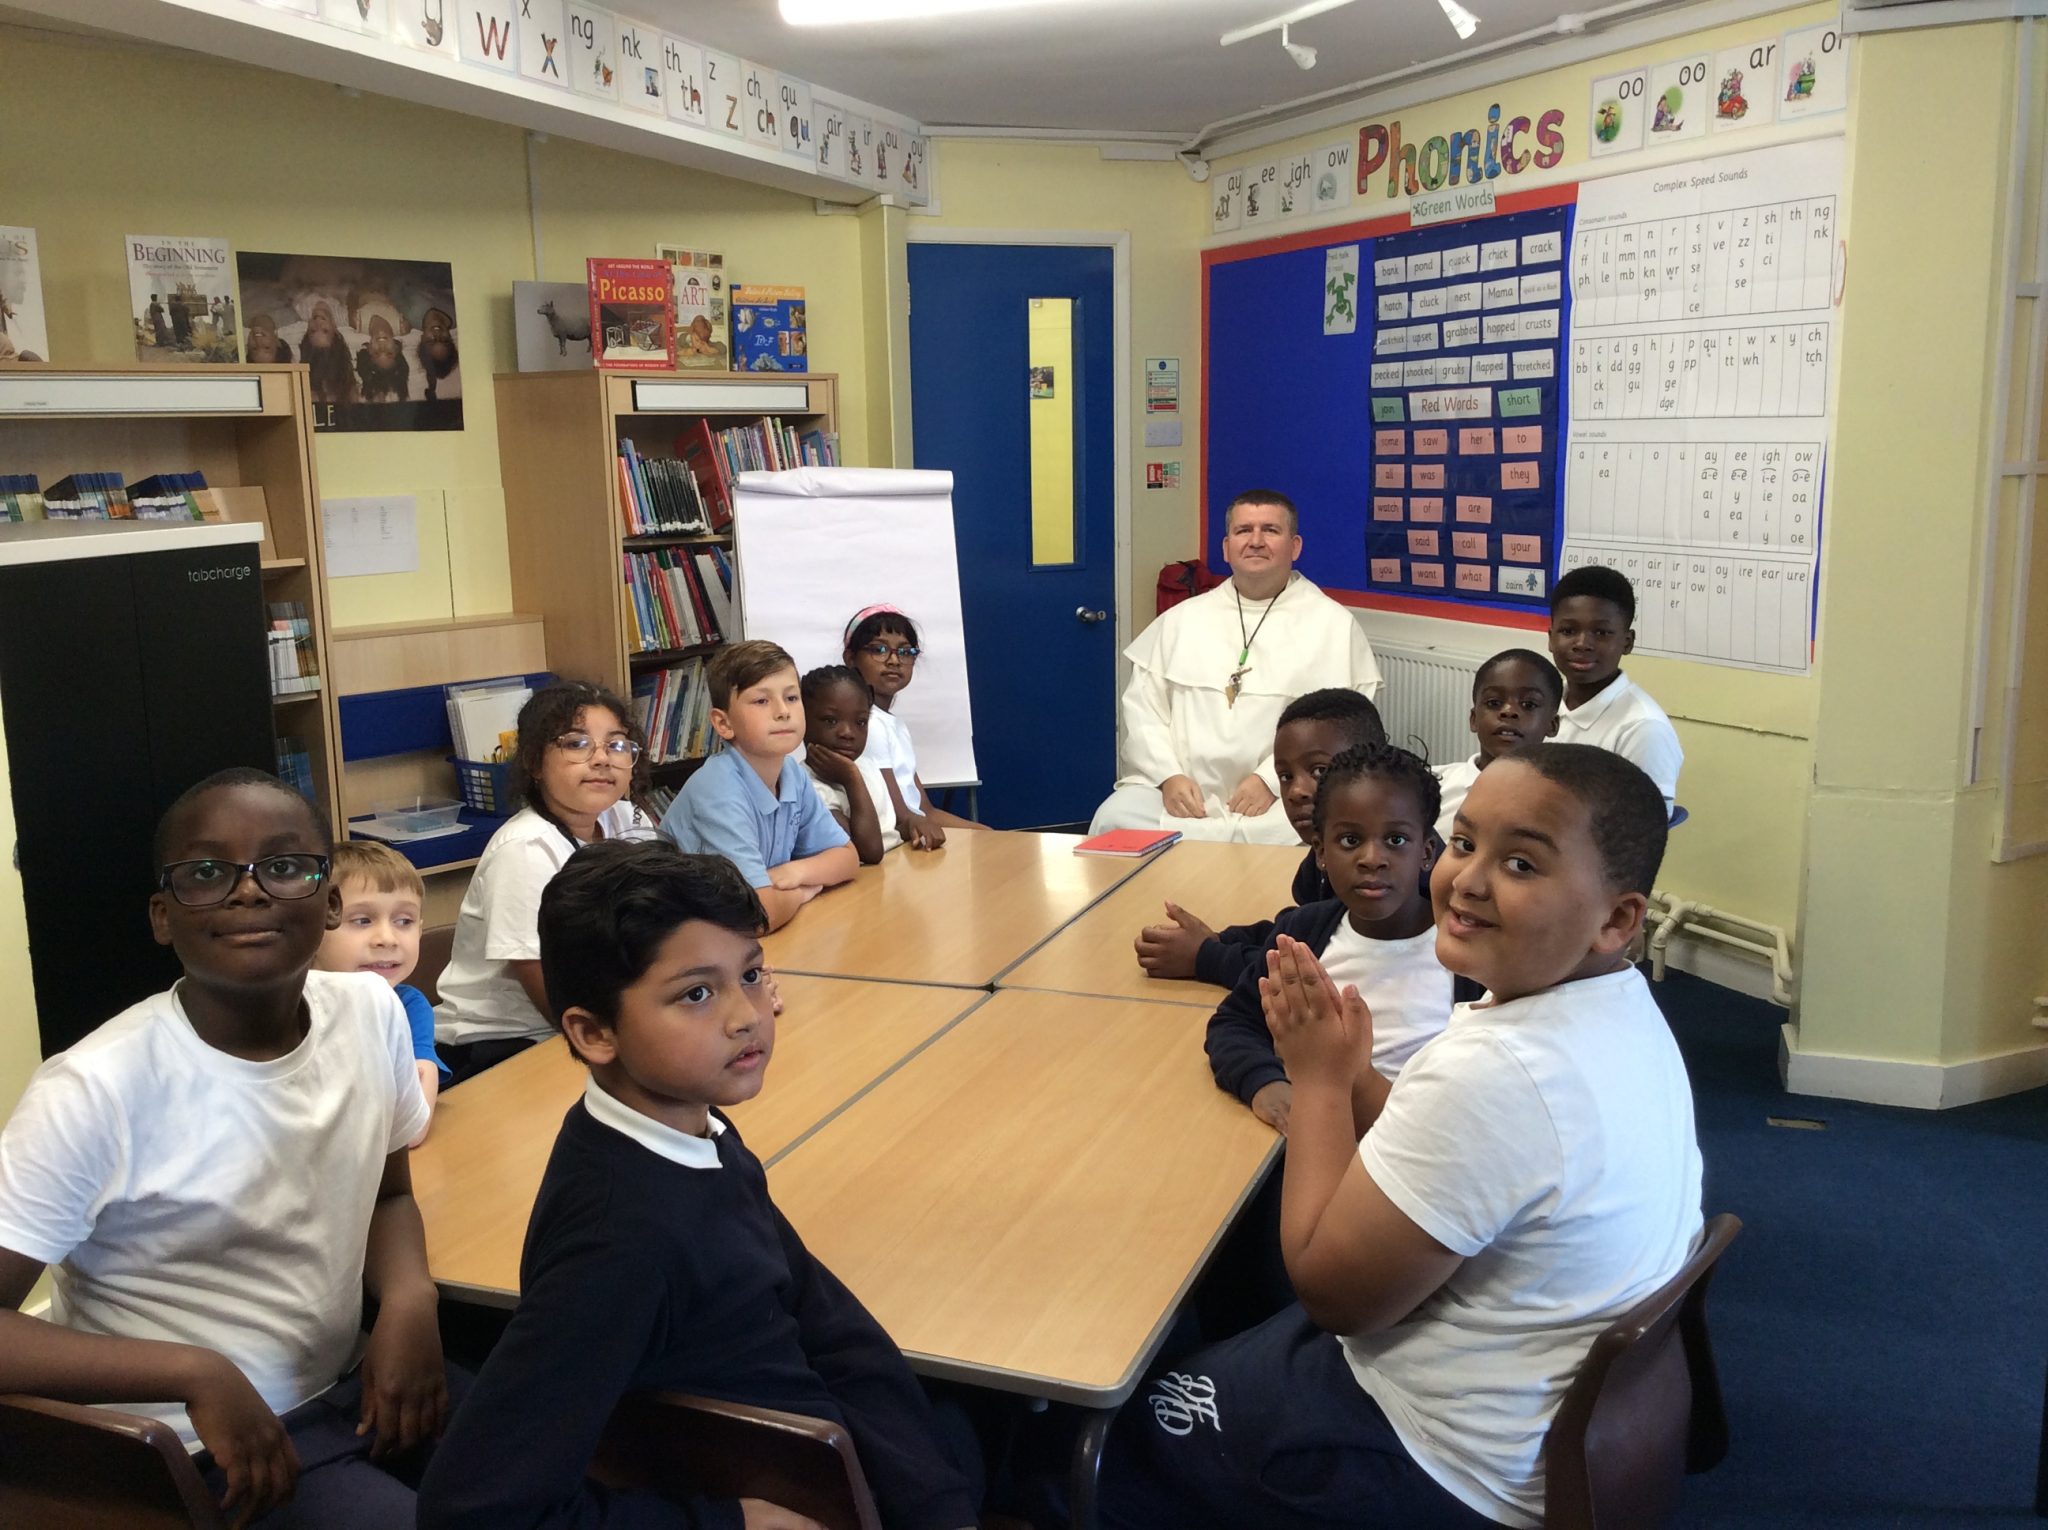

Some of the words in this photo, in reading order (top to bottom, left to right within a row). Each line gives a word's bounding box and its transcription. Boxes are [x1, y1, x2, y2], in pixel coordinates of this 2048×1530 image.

[571, 14, 593, 49] ng
[622, 28, 642, 60] nk
[665, 42, 682, 73] th
[1750, 44, 1775, 69] ar
[1679, 62, 1706, 86] oo
[747, 70, 761, 99] ch
[1618, 77, 1644, 100] oo
[681, 75, 703, 115] th
[781, 85, 797, 111] qu
[757, 99, 777, 136] ch
[827, 114, 843, 137] air
[790, 115, 810, 149] qu
[863, 123, 871, 146] ir
[885, 131, 898, 149] ou
[911, 140, 923, 164] oy
[1328, 148, 1349, 167] ow
[1357, 102, 1565, 199] Phonics
[1261, 165, 1275, 184] ee
[1290, 156, 1311, 183] igh
[1227, 174, 1242, 194] ay
[1653, 179, 1687, 194] Complex
[1690, 174, 1715, 189] Speed
[1718, 169, 1748, 183] Sounds
[1420, 199, 1451, 217] Green
[1456, 190, 1493, 211] Words
[1623, 233, 1632, 242] m
[1647, 229, 1653, 239] n
[1742, 217, 1749, 226] z
[1764, 210, 1776, 224] sh
[1789, 207, 1801, 221] th
[1814, 204, 1830, 220] ng
[1530, 240, 1553, 254] crack
[1619, 251, 1636, 262] mm
[1643, 249, 1656, 259] nn
[1668, 246, 1678, 256] rr
[1712, 240, 1726, 250] ve
[1737, 238, 1750, 248] zz
[1765, 233, 1774, 245] ti
[1813, 226, 1829, 239] nk
[133, 243, 225, 264] BEGINNING
[1488, 247, 1508, 260] chick
[1382, 264, 1399, 276] bank
[1414, 259, 1433, 275] pond
[1578, 273, 1590, 288] ph
[1601, 271, 1610, 283] le
[1619, 268, 1635, 280] mb
[1643, 266, 1655, 278] kn
[1762, 253, 1772, 266] ci
[600, 278, 665, 302] Picasso
[681, 286, 707, 306] ART
[1454, 291, 1471, 302] nest
[1488, 287, 1514, 299] Mama
[1644, 287, 1657, 301] gn
[1735, 277, 1747, 288] se
[1384, 301, 1402, 311] hatch
[1420, 295, 1439, 308] cluck
[1689, 303, 1700, 312] ce
[1486, 320, 1515, 336] hopped
[1525, 319, 1551, 330] crusts
[1412, 332, 1432, 346] upset
[1446, 323, 1477, 343] grabbed
[1703, 337, 1716, 352] qu
[1808, 327, 1821, 342] ch
[1476, 360, 1503, 375] flapped
[1516, 360, 1551, 372] stretched
[1576, 363, 1588, 374] bb
[1611, 360, 1623, 372] dd
[1628, 361, 1641, 375] gg
[1684, 358, 1696, 371] pp
[1725, 355, 1734, 367] tt
[1742, 353, 1759, 366] wh
[1805, 350, 1822, 363] tch
[1374, 368, 1399, 384] pecked
[1406, 365, 1433, 377] shocked
[1443, 364, 1465, 380] grubs
[1594, 379, 1604, 392] ck
[1628, 380, 1640, 393] gu
[1664, 379, 1676, 392] ge
[1421, 398, 1440, 413] Red
[1444, 397, 1478, 412] Words
[1506, 393, 1530, 405] short
[1660, 398, 1674, 412] dge
[1381, 437, 1399, 446] some
[1422, 437, 1438, 446] saw
[1470, 433, 1483, 445] her
[1517, 433, 1526, 443] to
[1704, 452, 1718, 464] ay
[1734, 452, 1747, 461] ee
[1762, 449, 1781, 465] igh
[1794, 452, 1813, 462] ow
[1385, 469, 1394, 479] all
[1419, 471, 1435, 481] was
[1510, 468, 1530, 484] they
[1599, 468, 1609, 478] ea
[1734, 491, 1740, 504] y
[1763, 490, 1773, 501] ie
[1792, 492, 1807, 503] oa
[1377, 502, 1399, 513] watch
[1423, 502, 1432, 514] of
[1468, 503, 1481, 513] are
[1730, 510, 1743, 521] ea
[1415, 535, 1430, 546] said
[1462, 538, 1476, 549] call
[1762, 532, 1769, 545] y
[1790, 533, 1805, 544] oe
[1510, 543, 1531, 555] your
[187, 565, 251, 583] tabcharge
[1379, 566, 1393, 576] you
[1417, 568, 1437, 579] want
[1568, 554, 1579, 563] oo
[1587, 556, 1598, 564] oo
[1607, 557, 1617, 566] ar
[1627, 559, 1638, 568] or
[1647, 558, 1662, 570] air
[1672, 560, 1680, 571] ir
[1693, 563, 1705, 574] ou
[1715, 566, 1728, 578] oy
[1739, 565, 1753, 578] ire
[1761, 568, 1780, 580] ear
[1787, 570, 1806, 582] ure
[1462, 571, 1482, 582] what
[1646, 578, 1662, 588] are
[1671, 580, 1681, 589] ur
[1691, 583, 1706, 593] ow
[1716, 583, 1727, 595] oi
[1670, 599, 1680, 609] er
